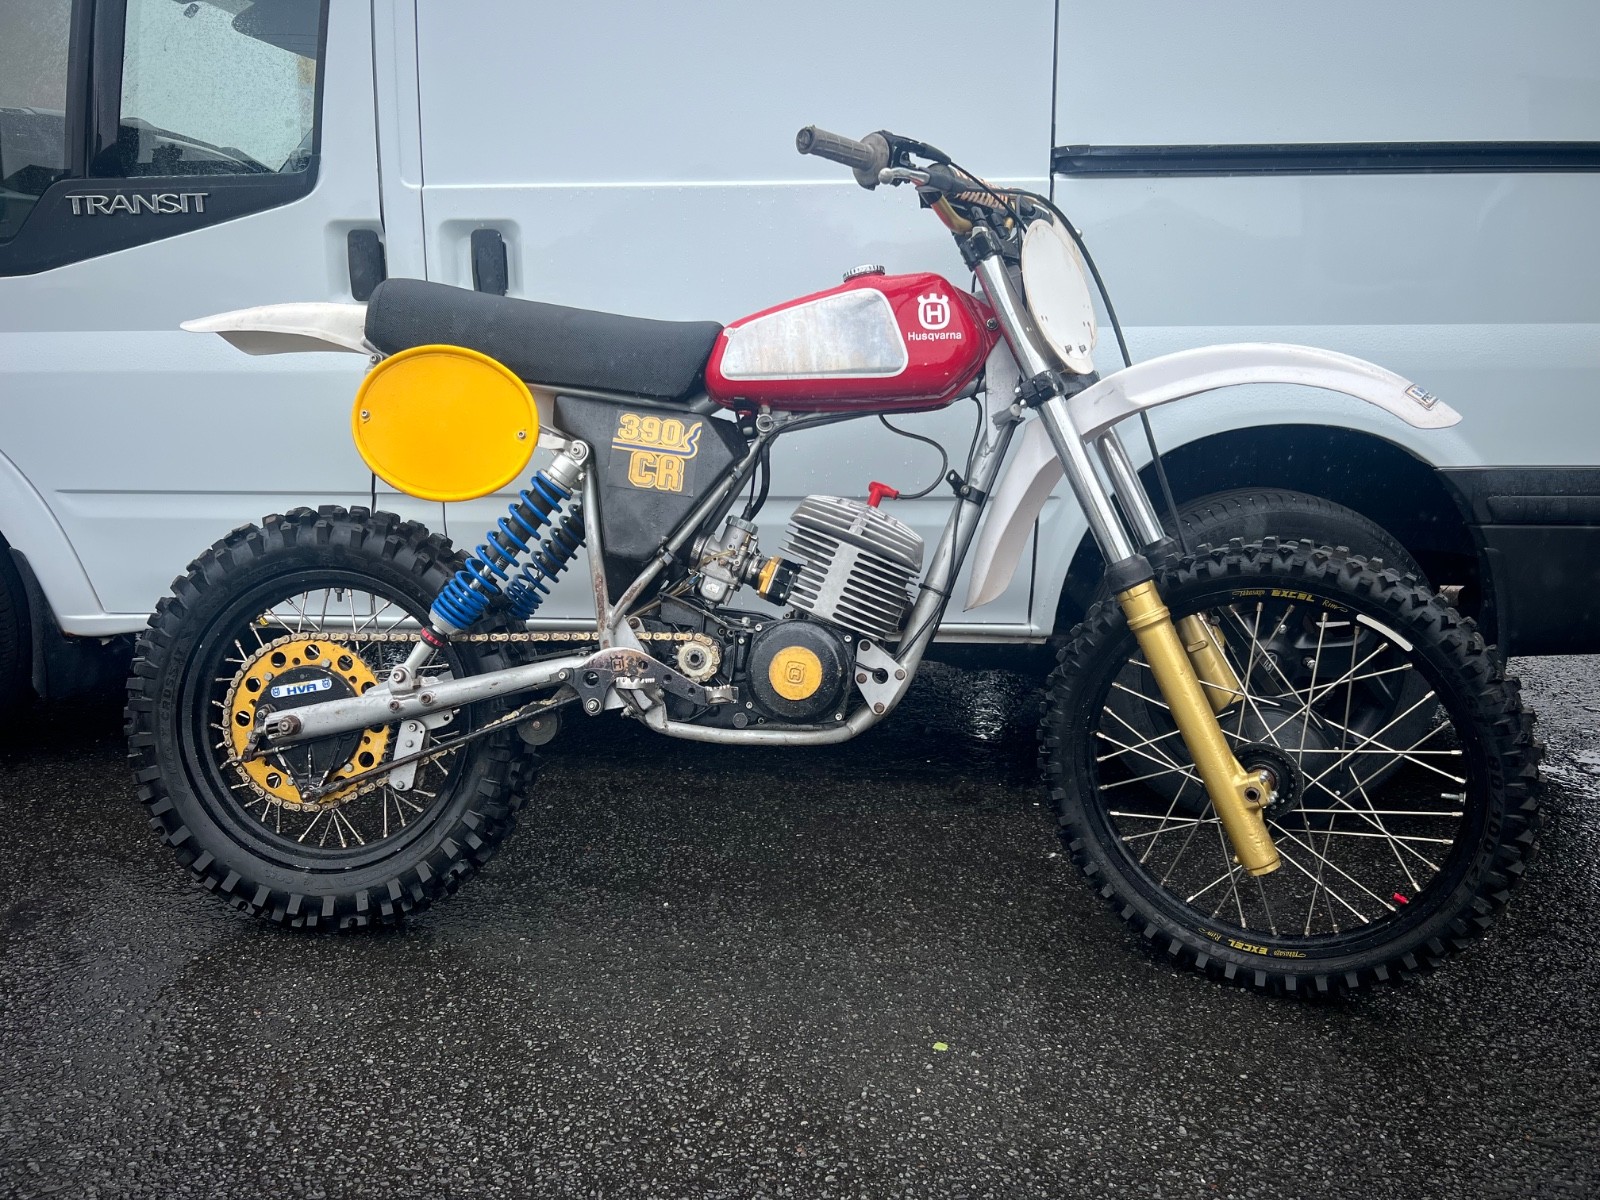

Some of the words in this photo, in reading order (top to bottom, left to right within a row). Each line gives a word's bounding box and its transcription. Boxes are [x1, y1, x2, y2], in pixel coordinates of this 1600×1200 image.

[65, 193, 208, 215] TRANSIT
[954, 191, 1008, 210] RENTHA
[907, 331, 962, 342] Husqvarna
[618, 413, 685, 447] 390
[628, 450, 685, 492] CR
[1271, 589, 1315, 602] EXCEL
[286, 683, 317, 696] HVA
[1228, 939, 1269, 956] EXCEL
